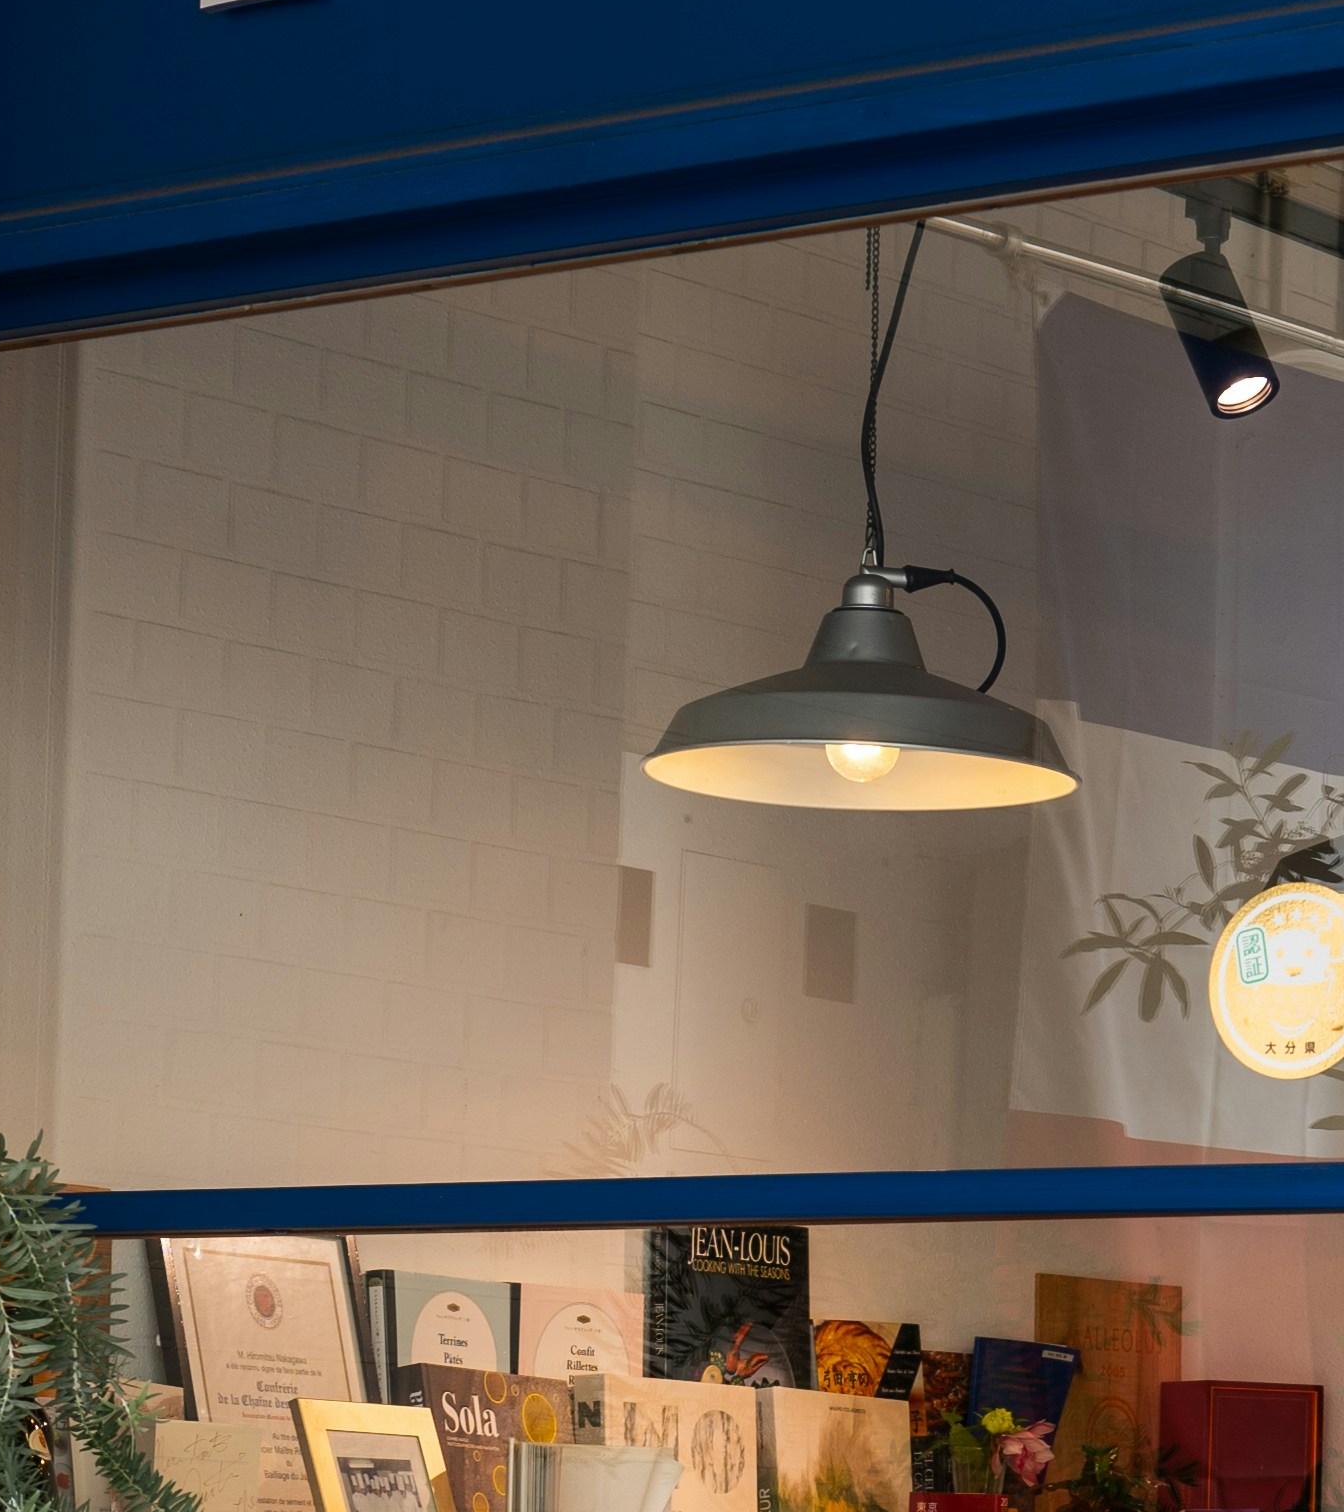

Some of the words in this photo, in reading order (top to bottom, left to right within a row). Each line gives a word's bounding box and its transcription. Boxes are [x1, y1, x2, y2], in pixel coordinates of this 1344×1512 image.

[1264, 1041, 1316, 1055] 大分県
[692, 1258, 727, 1274] COOKING
[728, 1262, 746, 1276] WITH
[747, 1264, 759, 1278] THE
[760, 1266, 791, 1280] SEASONS
[438, 1333, 469, 1348] Terrines
[570, 1344, 595, 1357] Confit
[566, 1359, 598, 1372] Rillettes
[441, 1390, 500, 1438] Sola
[916, 1501, 939, 1512] 東京
